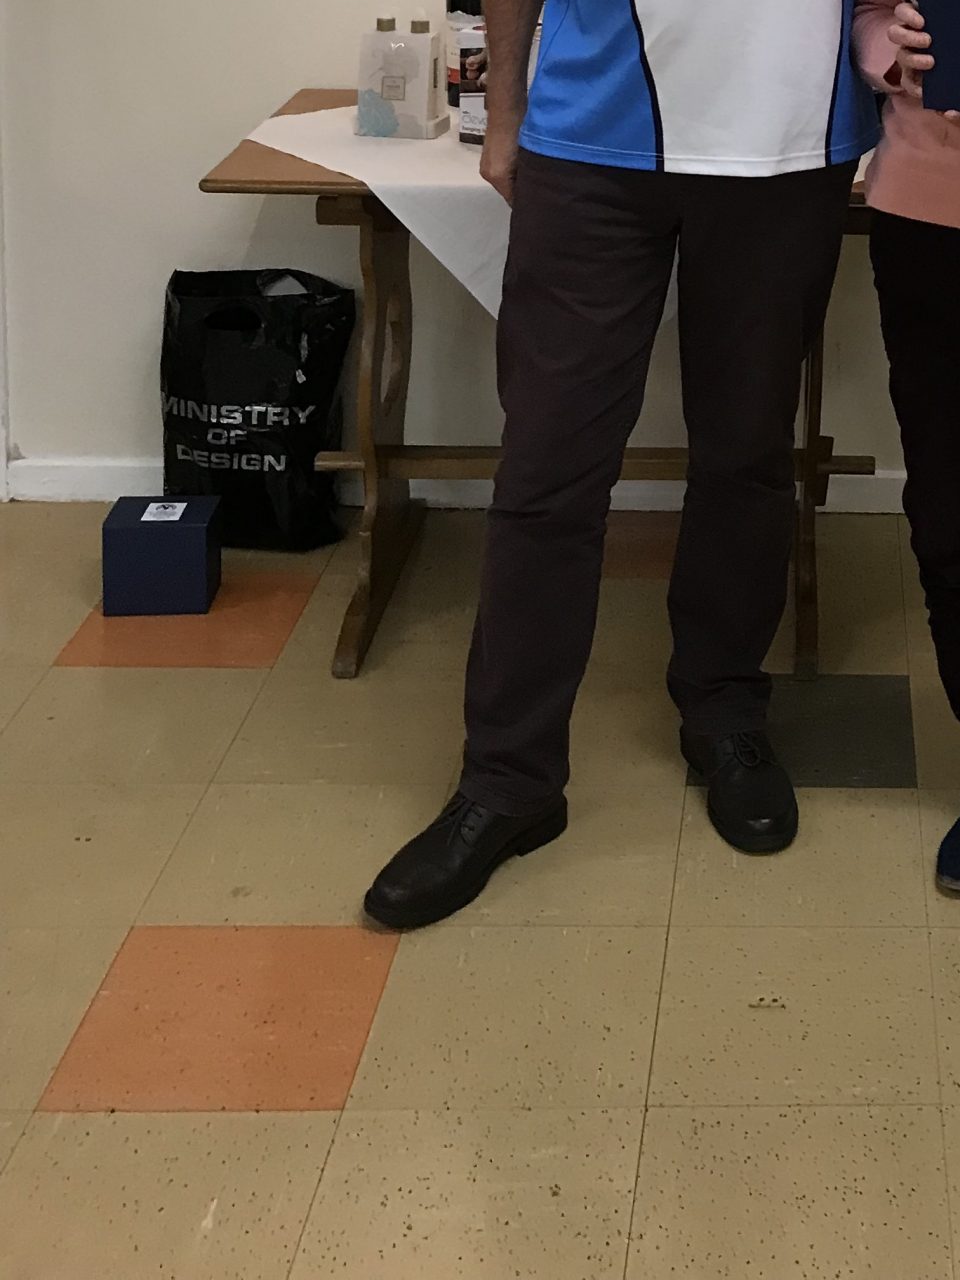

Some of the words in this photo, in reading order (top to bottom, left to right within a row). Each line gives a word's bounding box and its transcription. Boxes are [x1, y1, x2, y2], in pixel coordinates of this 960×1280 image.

[161, 391, 317, 426] MINISTRY
[206, 427, 248, 445] OF
[176, 444, 287, 472] DESIGN
